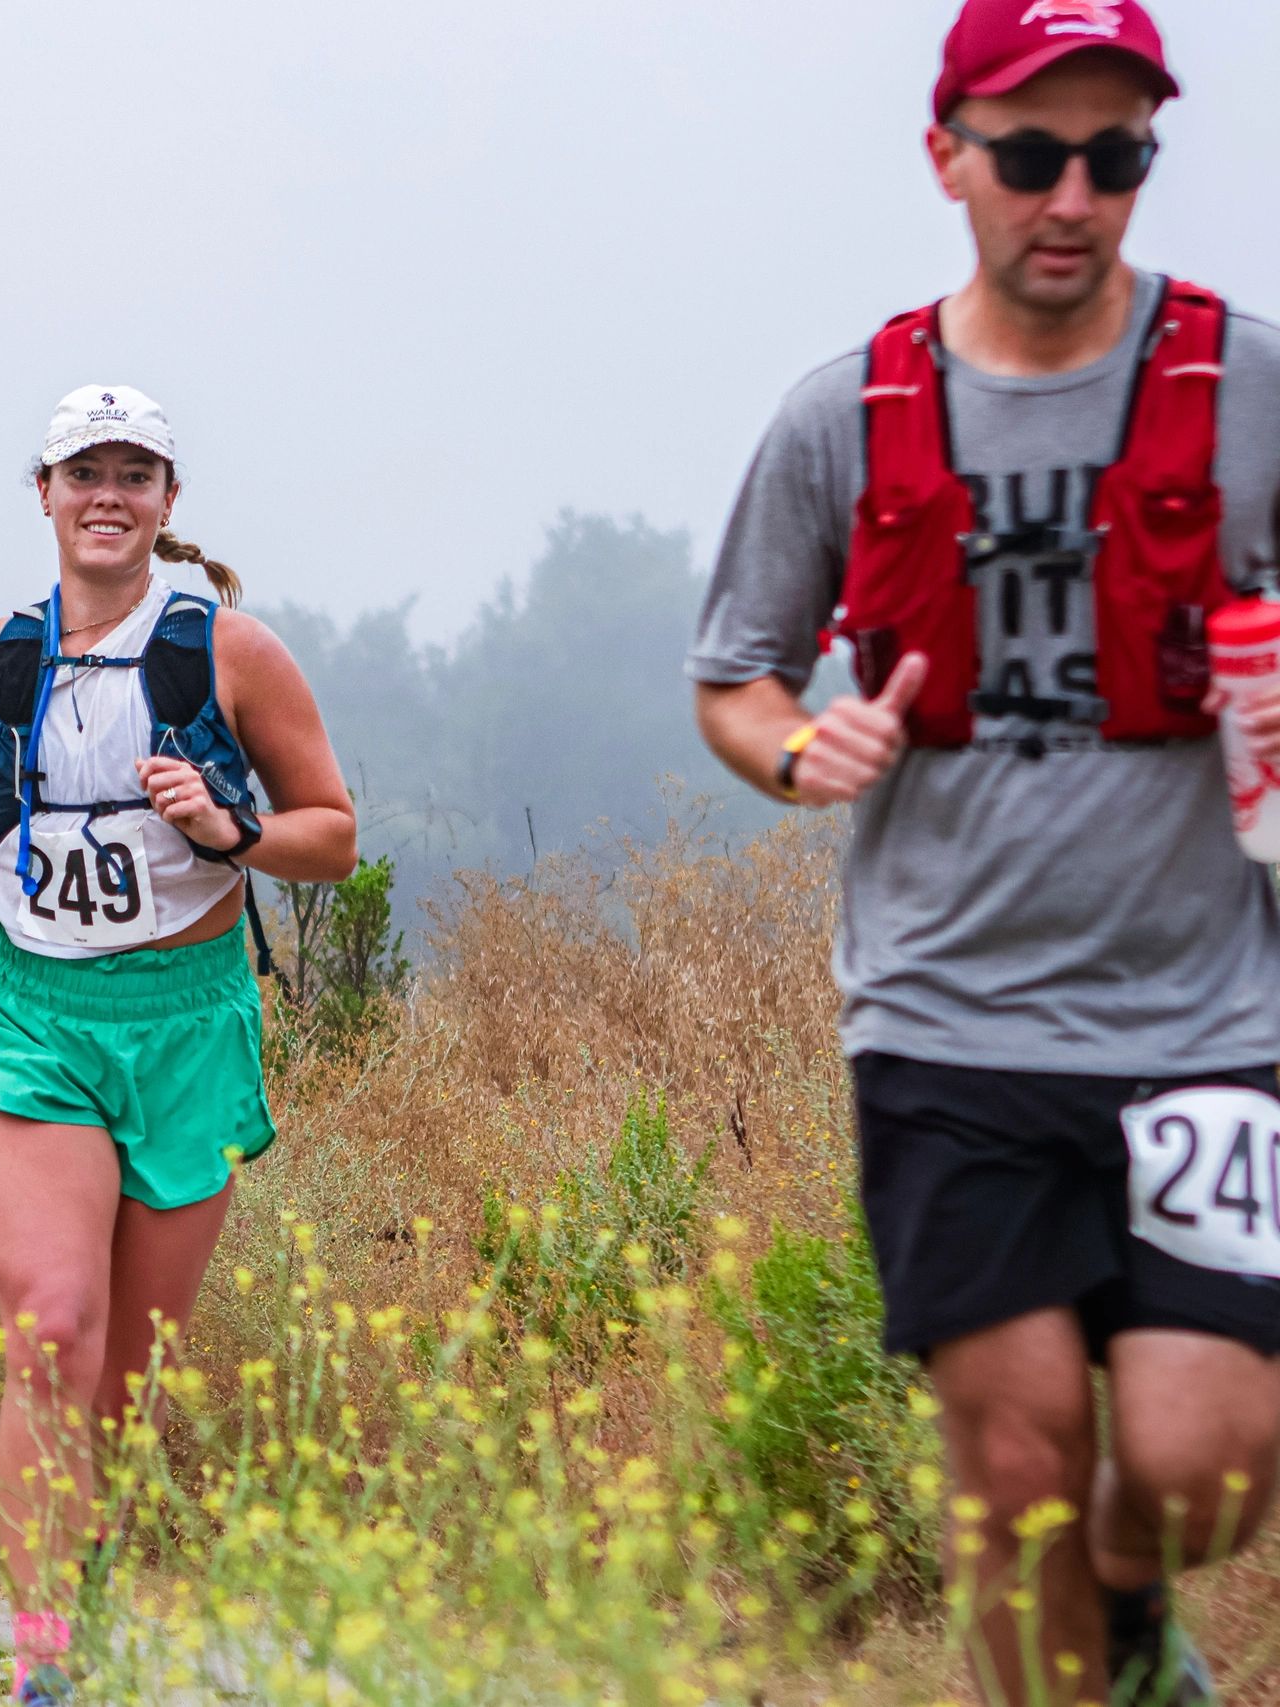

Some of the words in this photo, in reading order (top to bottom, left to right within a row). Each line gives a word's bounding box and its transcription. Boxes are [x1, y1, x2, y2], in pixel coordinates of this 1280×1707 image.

[86, 409, 129, 417] WAILEA
[1004, 560, 1083, 636] IT
[28, 842, 141, 926] 249
[1151, 1115, 1280, 1234] 24
